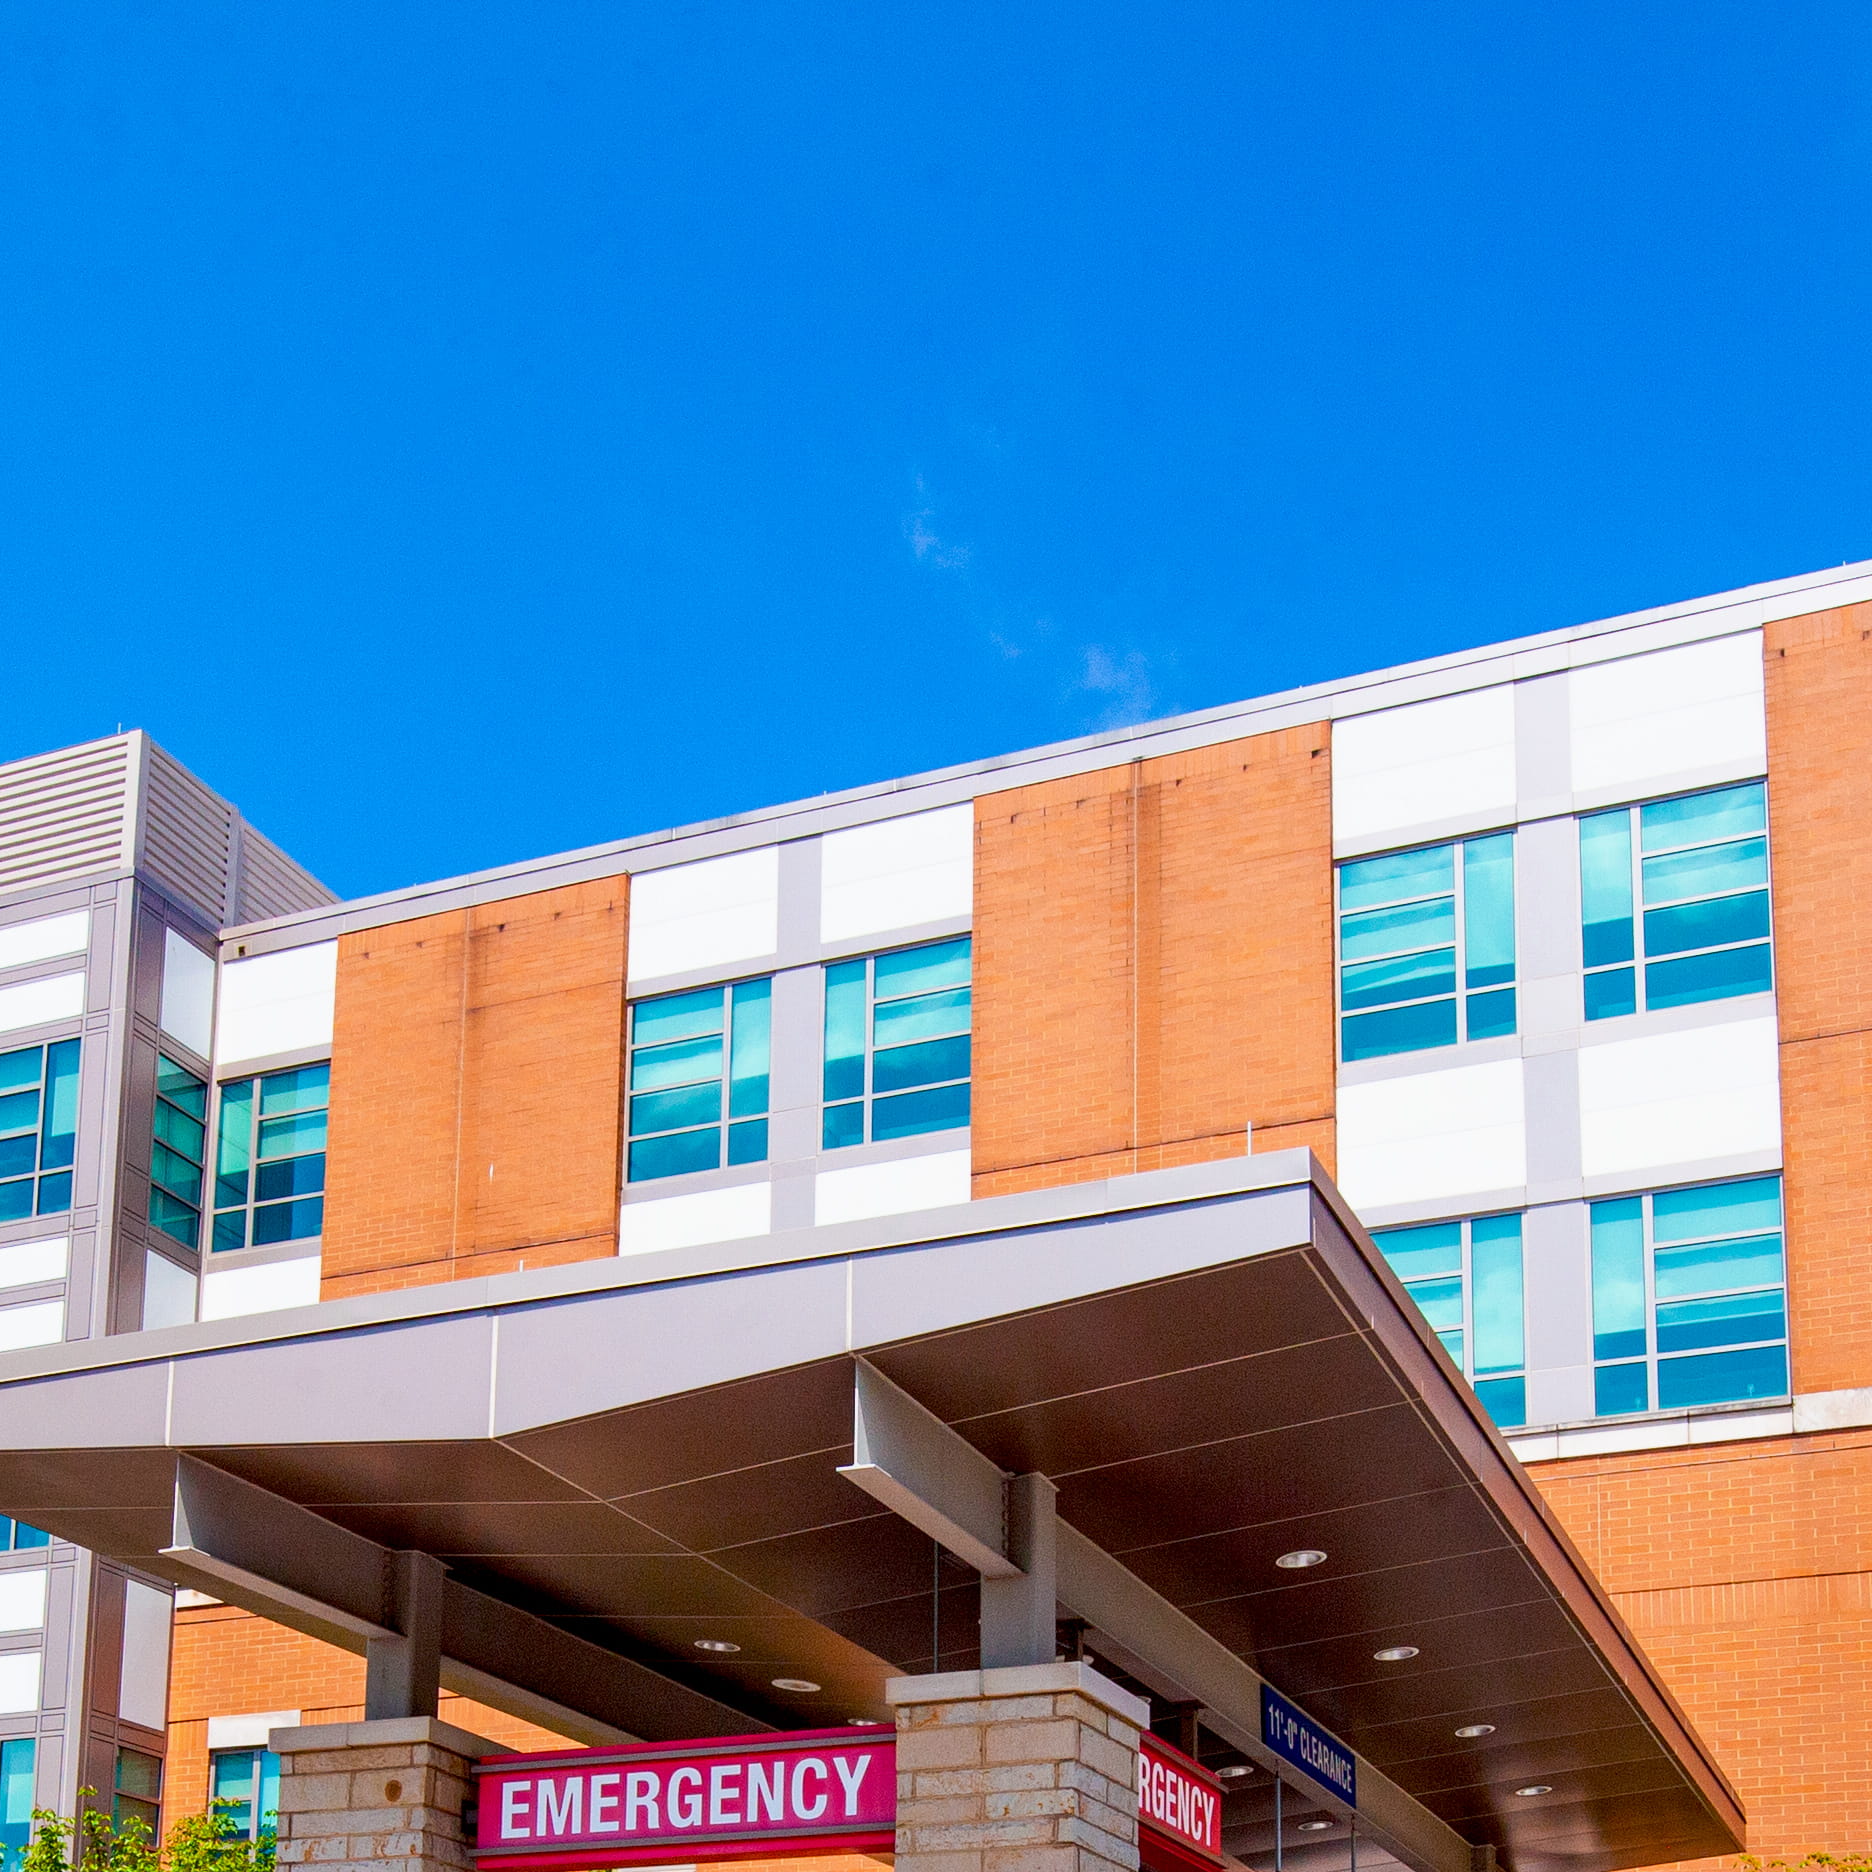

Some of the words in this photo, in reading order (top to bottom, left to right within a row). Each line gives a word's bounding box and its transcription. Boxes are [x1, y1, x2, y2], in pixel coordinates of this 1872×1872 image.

[1268, 1703, 1298, 1750] 11'-0"
[1300, 1727, 1353, 1794] CLEARANCE
[500, 1754, 872, 1840] EMERGENCY
[1138, 1752, 1215, 1847] RGENCY
